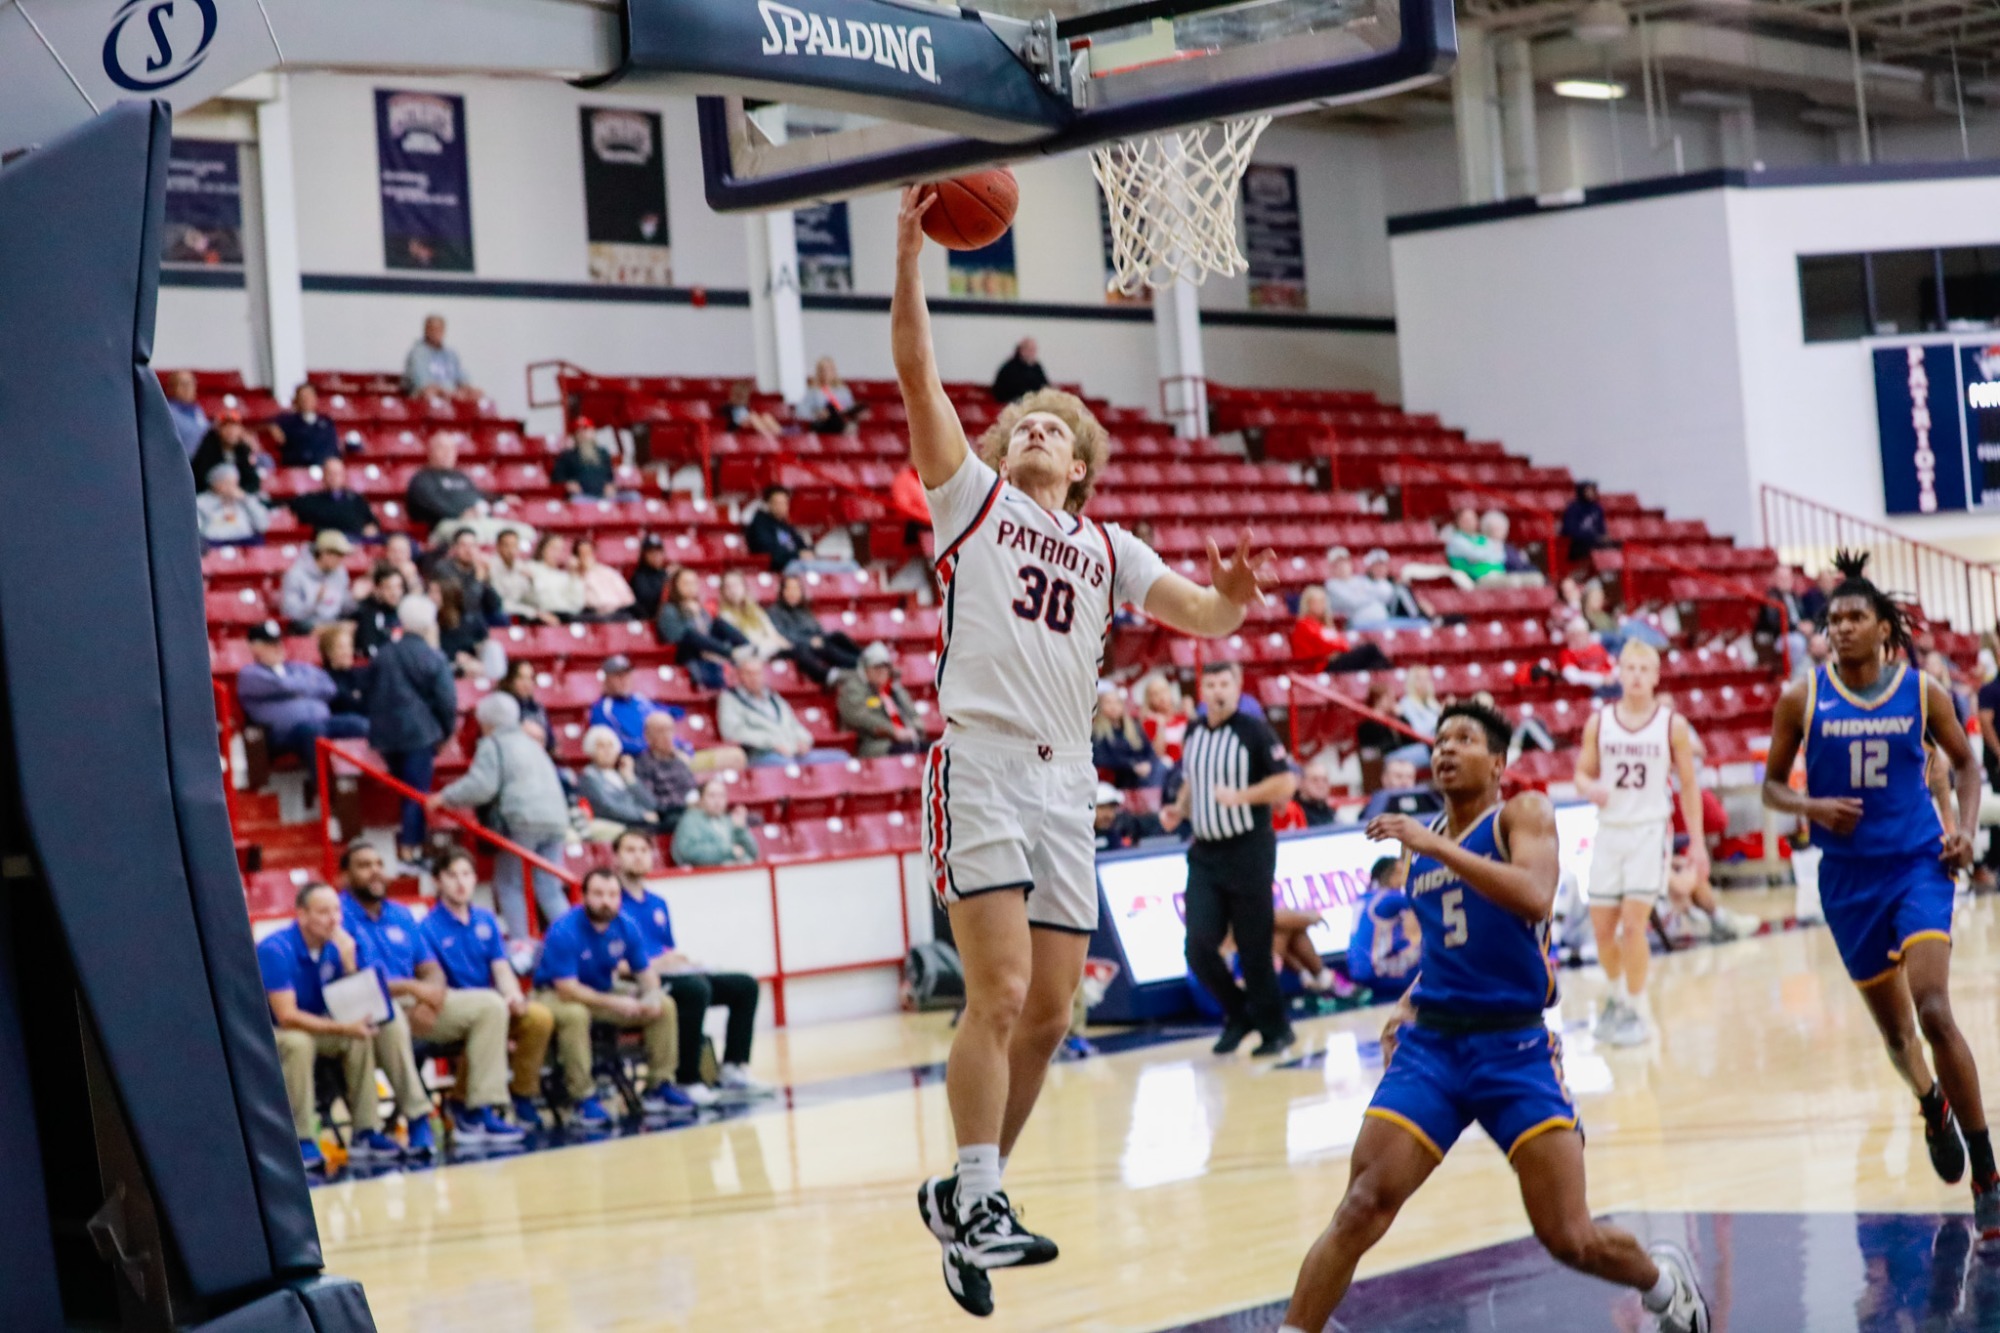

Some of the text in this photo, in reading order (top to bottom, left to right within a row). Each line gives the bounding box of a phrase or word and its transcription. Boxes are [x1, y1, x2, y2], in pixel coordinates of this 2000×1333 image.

[758, 0, 937, 84] SPALDING
[997, 520, 1104, 588] PATRIOTS
[1012, 565, 1075, 635] 30
[1822, 716, 1914, 738] MIDWAY
[1616, 762, 1646, 789] 23
[1849, 739, 1889, 789] 12
[1441, 887, 1468, 949] 5
